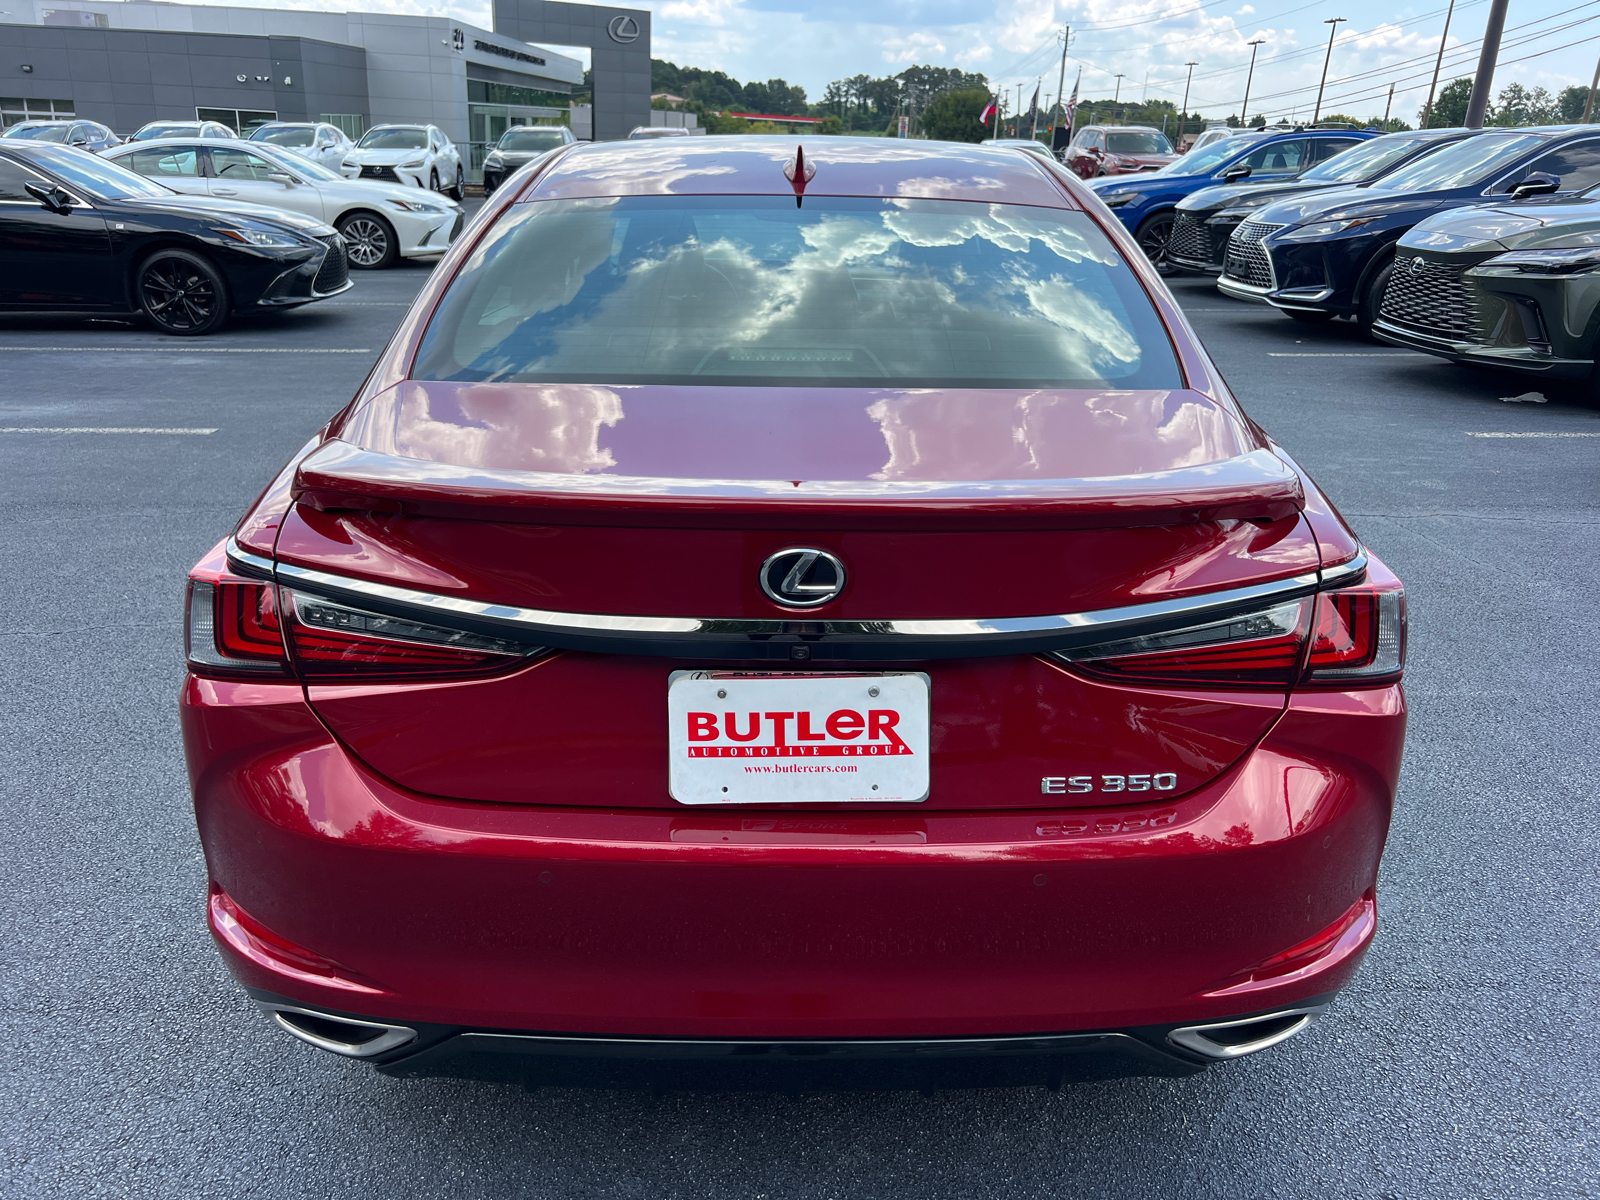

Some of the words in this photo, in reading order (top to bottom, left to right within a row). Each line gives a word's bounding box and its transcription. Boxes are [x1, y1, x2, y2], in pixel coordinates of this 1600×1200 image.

[689, 746, 820, 757] AUTOMOTIVE
[842, 745, 906, 756] GROUP
[744, 763, 858, 774] www.butlercars.com
[1041, 776, 1094, 794] ES
[1101, 772, 1177, 792] 350
